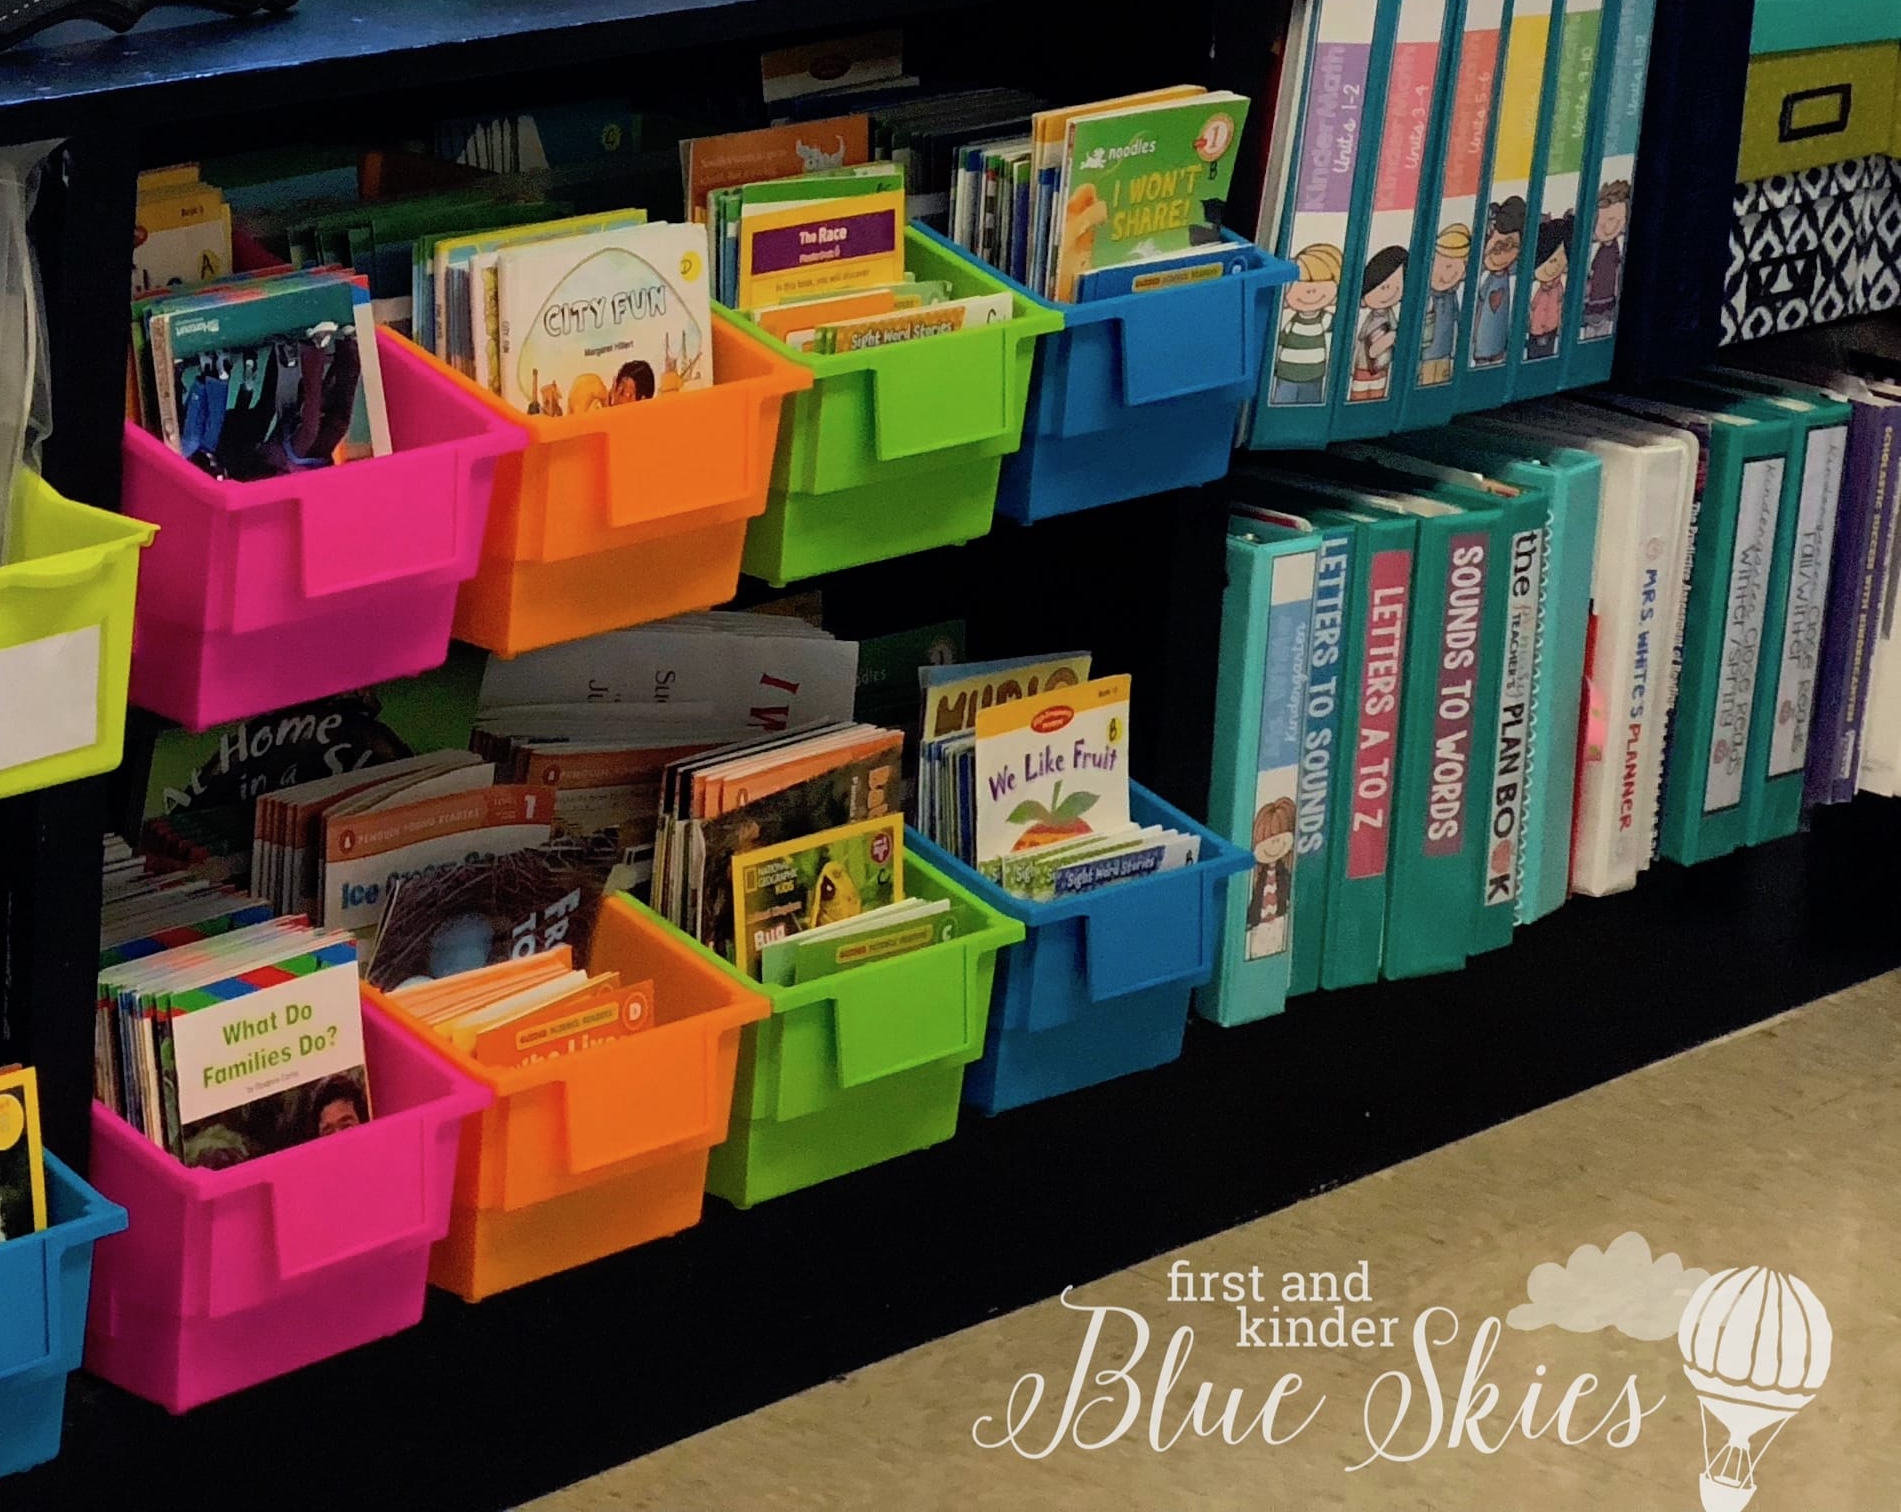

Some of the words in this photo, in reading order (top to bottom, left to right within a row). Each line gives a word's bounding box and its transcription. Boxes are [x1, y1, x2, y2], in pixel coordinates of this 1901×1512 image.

[1341, 83, 1360, 110] 1-2
[1108, 139, 1157, 161] noodles
[1210, 124, 1220, 148] 1
[1332, 118, 1357, 173] Units
[1130, 164, 1203, 205] WON'T
[799, 231, 817, 246] The
[818, 226, 848, 243] Race
[1111, 199, 1192, 242] SHARE!
[202, 254, 215, 279] A
[543, 296, 607, 338] CITY
[611, 284, 668, 326] FUN
[1512, 532, 1538, 597] the
[1312, 536, 1348, 668] LETTERS
[1442, 545, 1485, 671] SOUNDS
[1364, 586, 1405, 717] LETTERS
[1308, 676, 1337, 718] TO
[1439, 680, 1472, 721] TO
[219, 711, 343, 773] Home
[1360, 727, 1390, 751] A
[1499, 702, 1525, 776] PLAN
[988, 765, 1016, 802] We
[1024, 744, 1066, 782] Like
[1073, 738, 1118, 772] Fruit
[1358, 758, 1390, 800] TO
[1427, 730, 1468, 841] WORDS
[522, 793, 537, 820] 1
[1297, 727, 1332, 856] SOUNDS
[1353, 807, 1384, 833] Z
[1488, 783, 1518, 903] BOK
[341, 880, 379, 911] Ice
[223, 1011, 278, 1045] What
[286, 1004, 313, 1026] Do
[629, 1002, 642, 1022] D
[203, 1046, 293, 1088] Families
[299, 1025, 338, 1057] Do?
